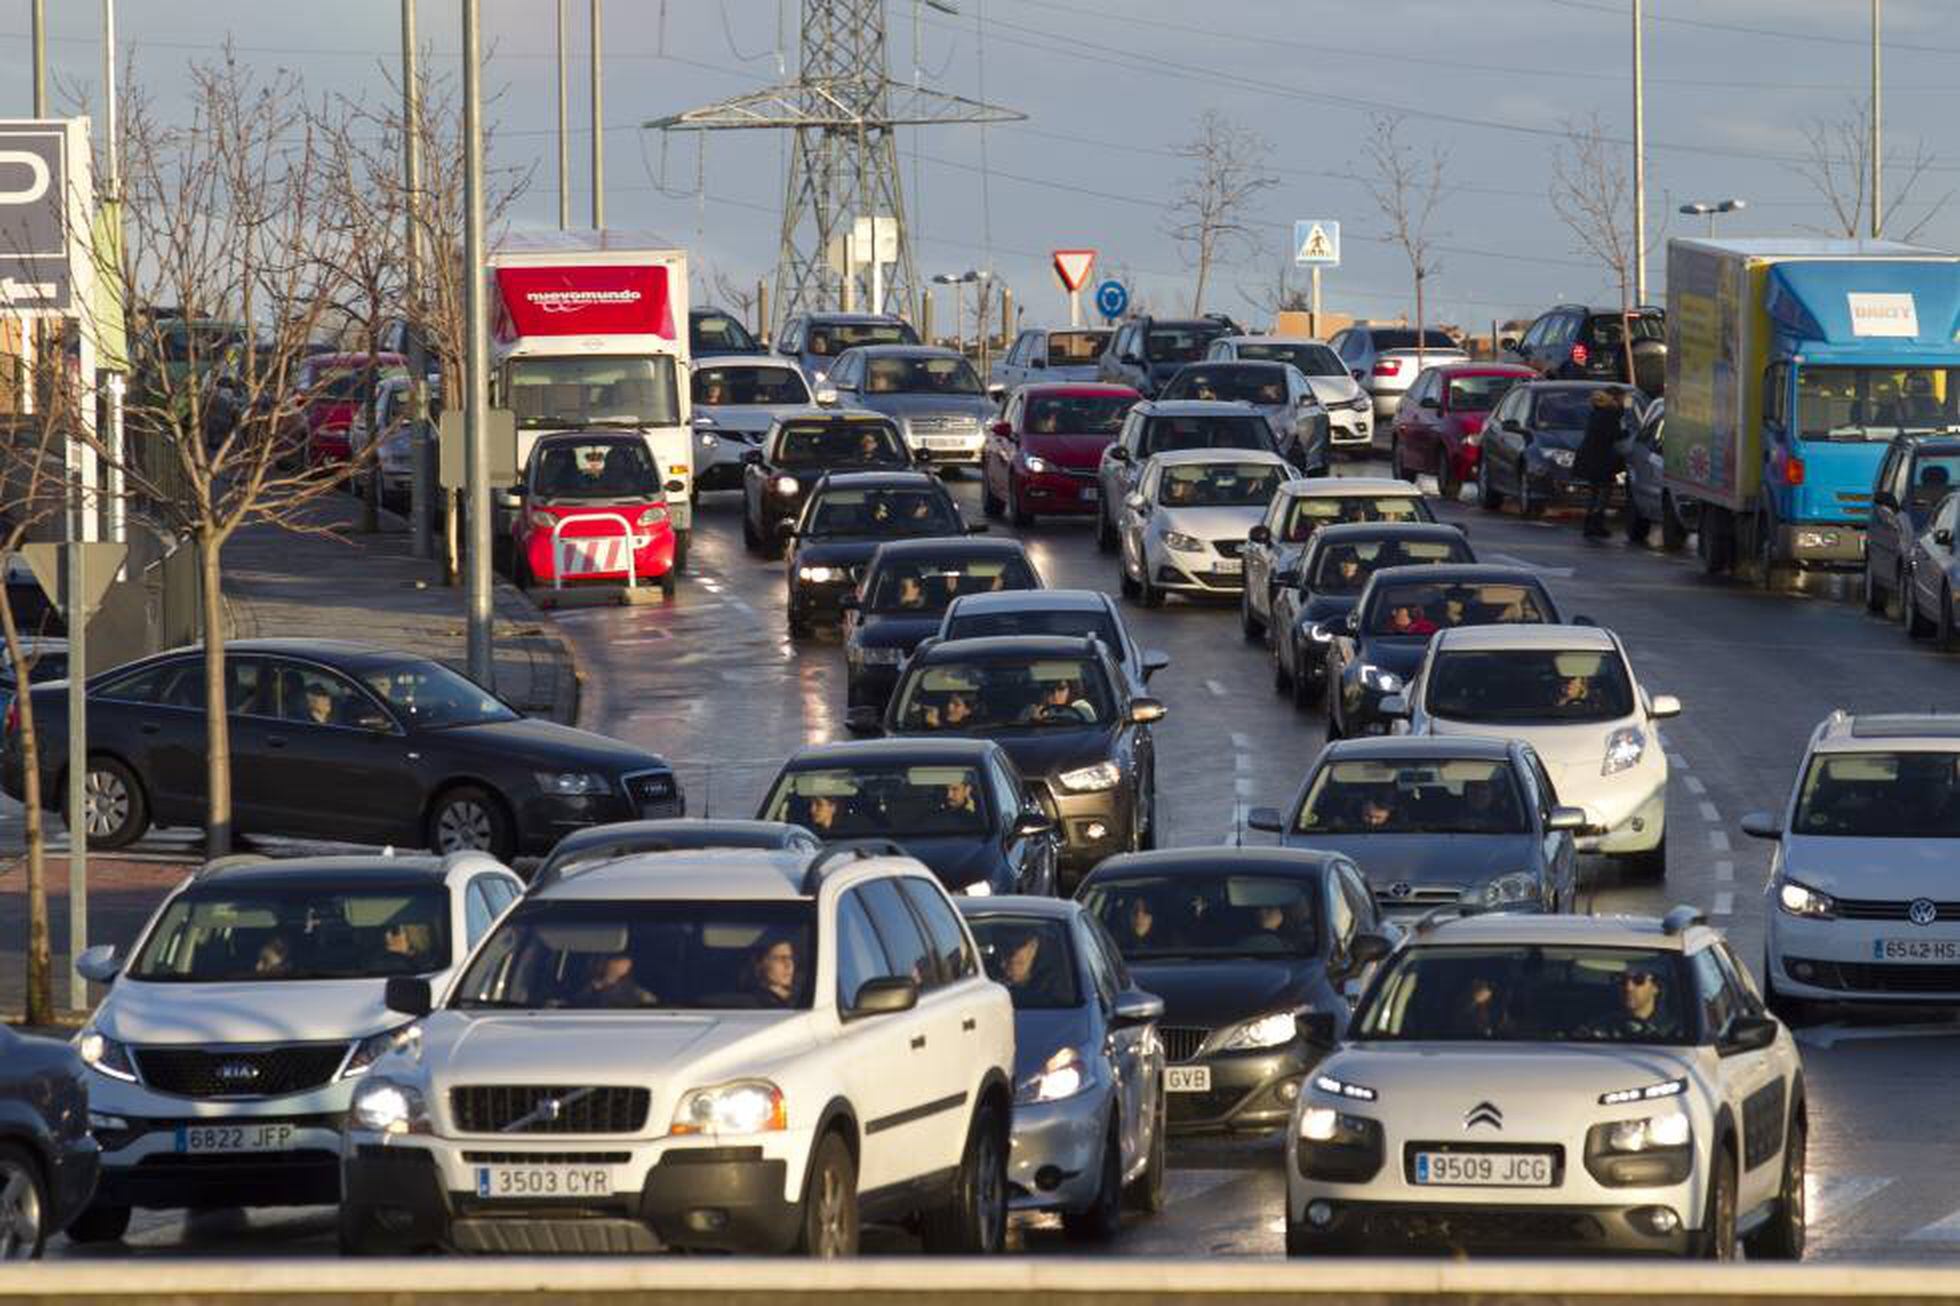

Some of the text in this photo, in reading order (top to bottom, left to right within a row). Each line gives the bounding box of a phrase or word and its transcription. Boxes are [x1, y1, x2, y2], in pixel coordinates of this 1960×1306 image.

[526, 289, 642, 302] nuevomundo
[1887, 942, 1960, 959] 6542 HS
[1169, 1070, 1205, 1088] GVB
[190, 1129, 244, 1149] 6822
[1433, 1157, 1546, 1180] 9509 JCG
[499, 1169, 608, 1193] 3503 CYR
